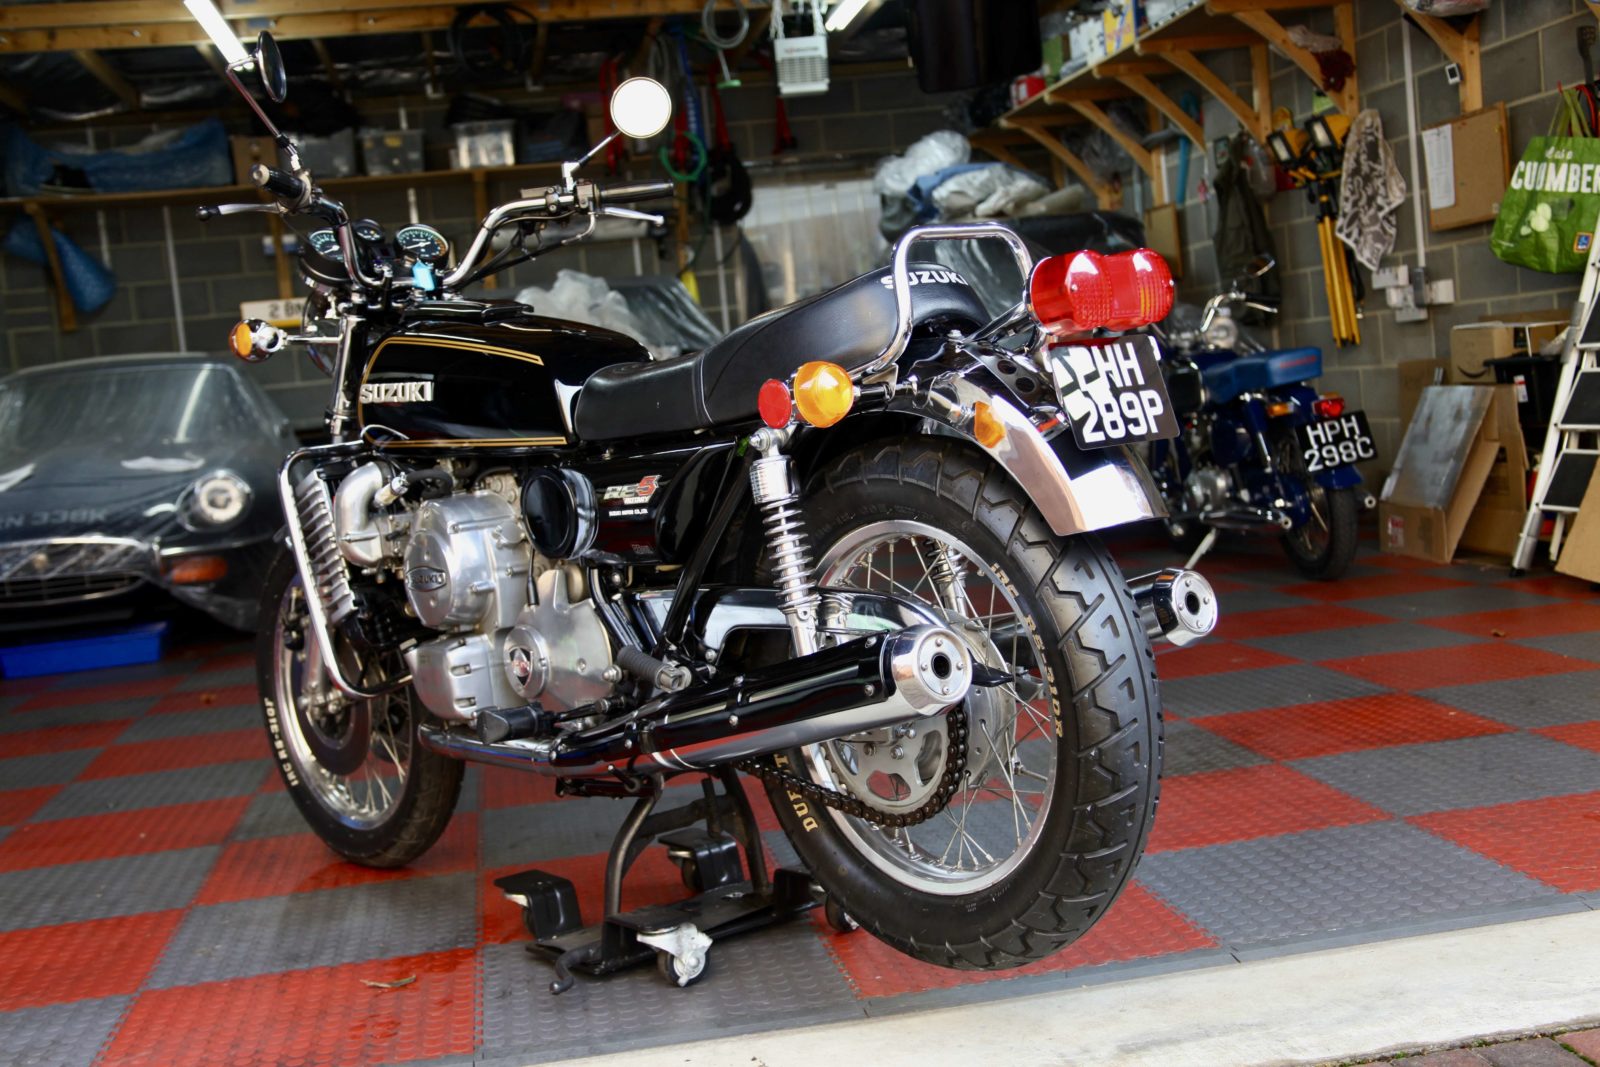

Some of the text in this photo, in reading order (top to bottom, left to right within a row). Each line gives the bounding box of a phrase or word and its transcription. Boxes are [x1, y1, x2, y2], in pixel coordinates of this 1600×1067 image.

[360, 382, 433, 404] SUZUKI
[1082, 389, 1164, 443] 289P
[1306, 415, 1361, 449] HPH
[1304, 437, 1375, 472] 298C
